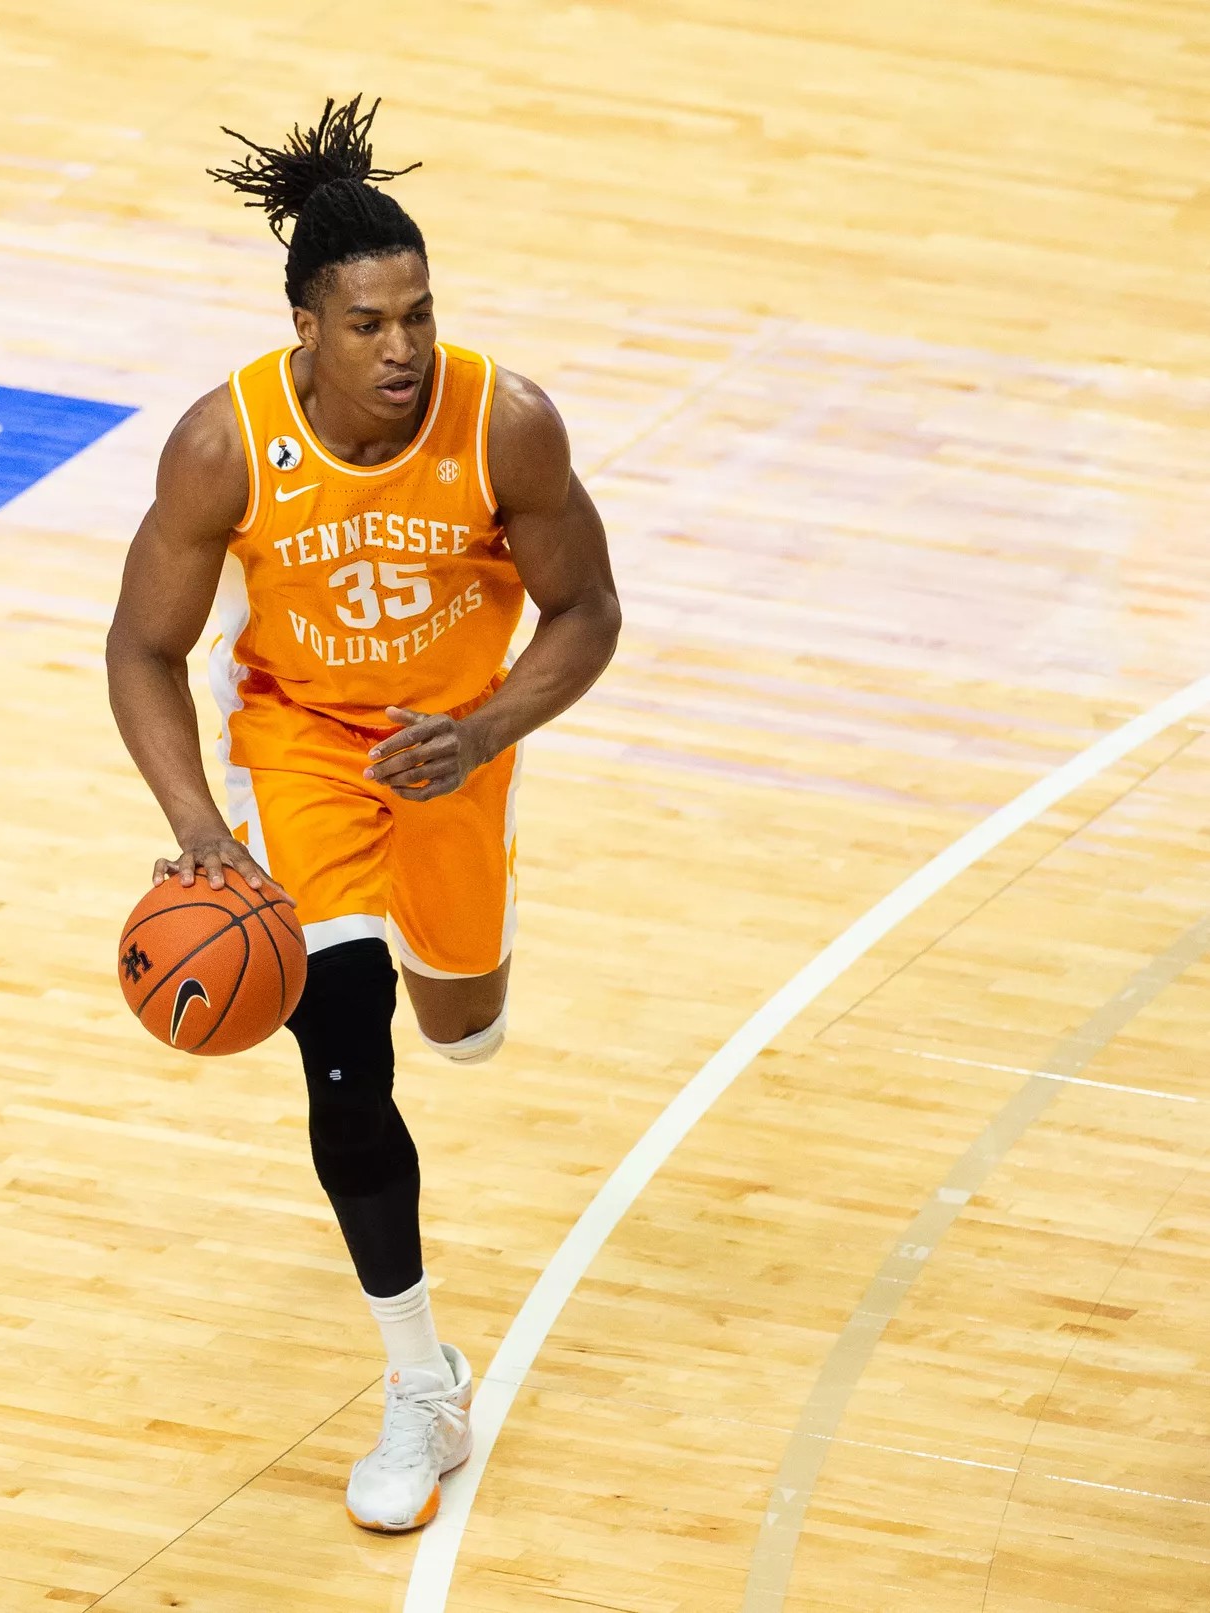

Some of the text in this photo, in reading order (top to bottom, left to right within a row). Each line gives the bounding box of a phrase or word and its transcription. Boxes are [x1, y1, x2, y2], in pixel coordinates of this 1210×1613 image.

[439, 460, 458, 482] SEC
[274, 512, 470, 567] TENNESSEE
[288, 580, 484, 667] VOLUNTEERS
[328, 559, 433, 630] 35
